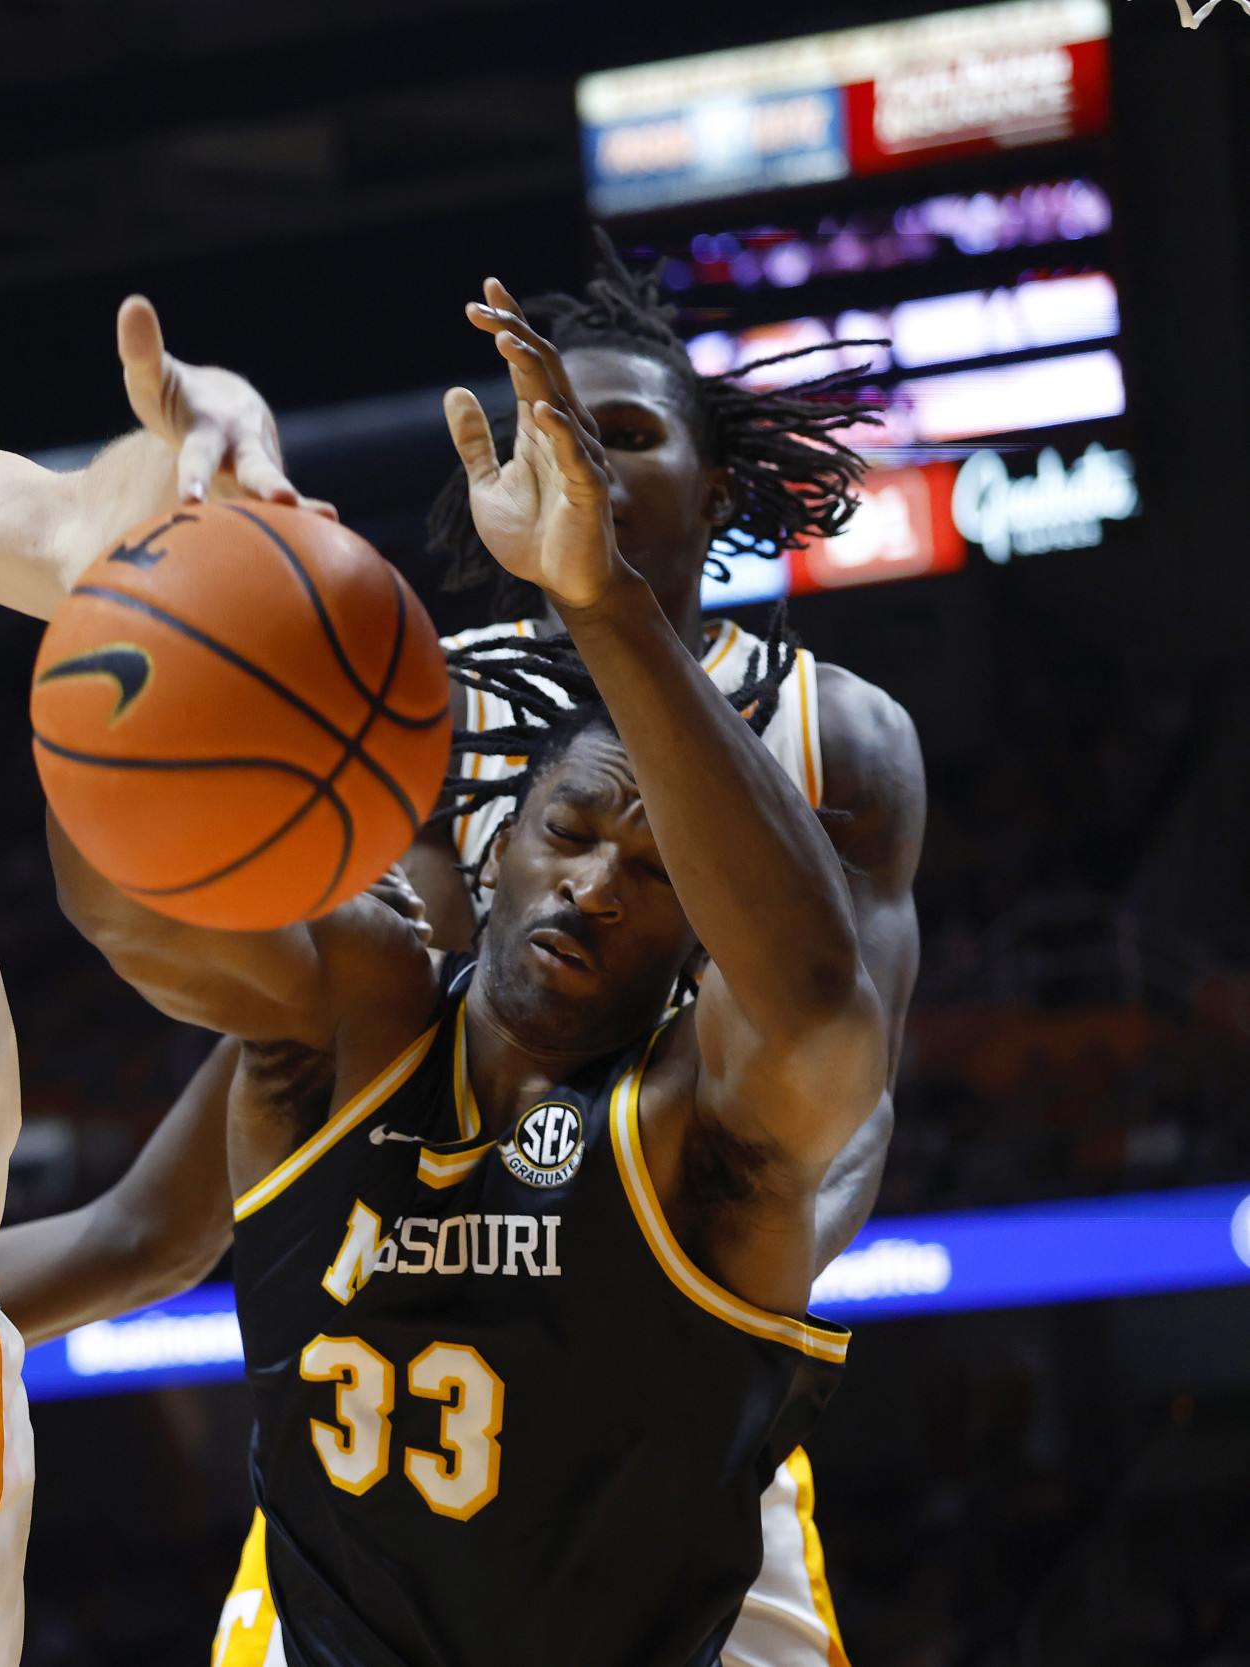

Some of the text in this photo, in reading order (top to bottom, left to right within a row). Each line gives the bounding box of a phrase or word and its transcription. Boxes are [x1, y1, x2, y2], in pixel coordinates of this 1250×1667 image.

[522, 1105, 578, 1165] SEC
[321, 1198, 562, 1307] MSSOURI
[299, 1333, 506, 1522] 33
